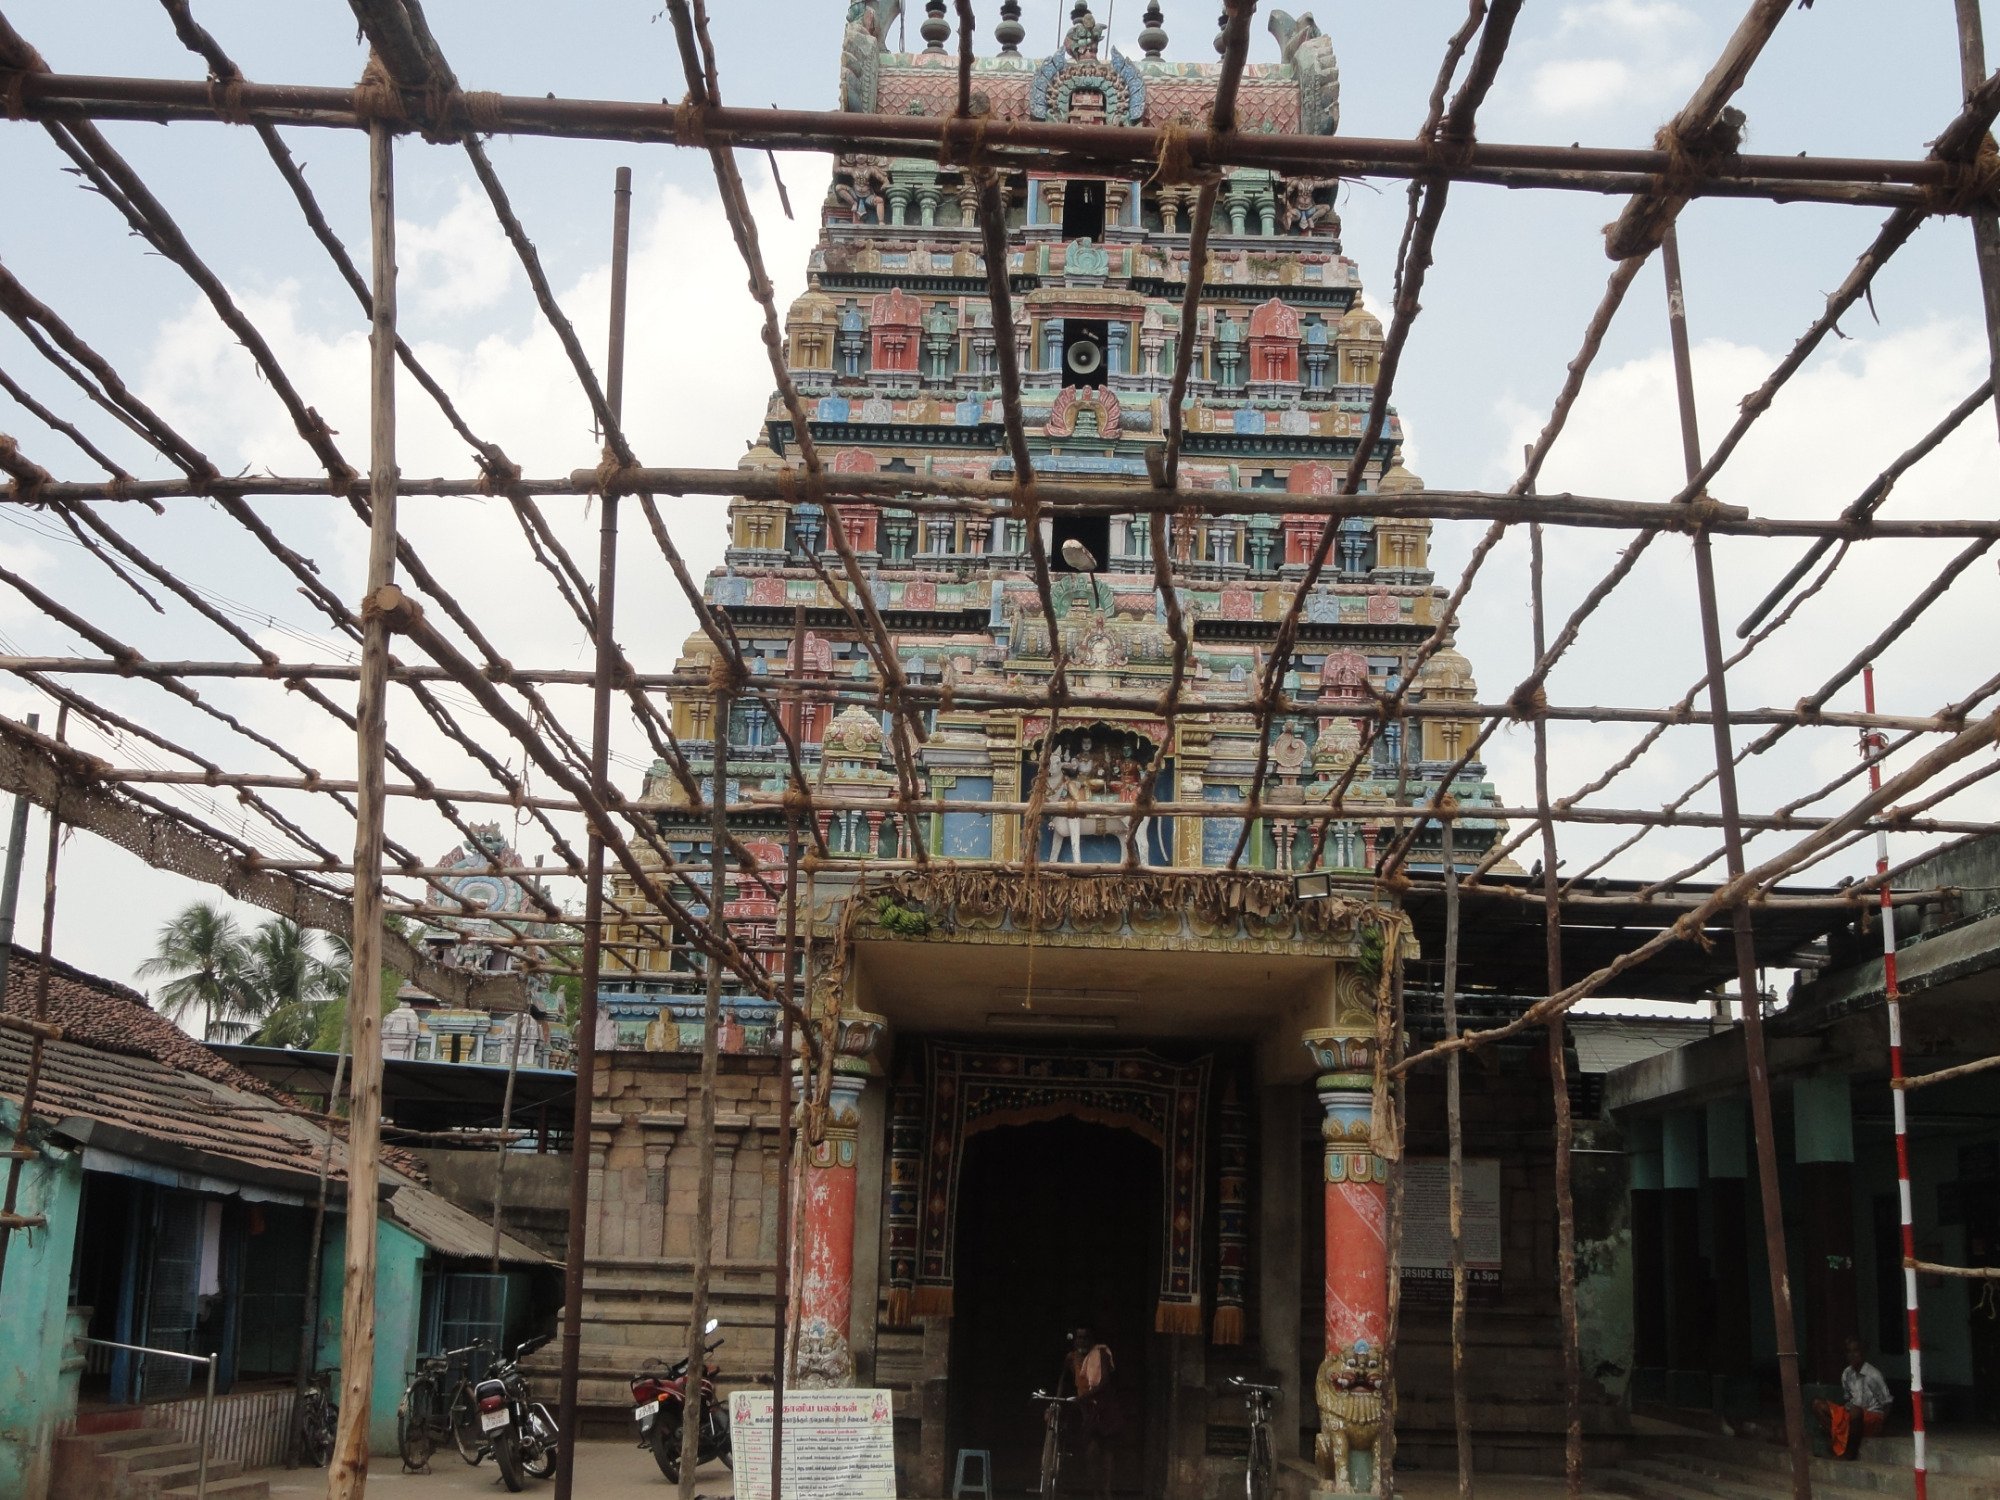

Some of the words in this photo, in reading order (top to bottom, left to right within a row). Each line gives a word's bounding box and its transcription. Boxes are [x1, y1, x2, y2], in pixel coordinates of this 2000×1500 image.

[1399, 1268, 1433, 1279] ERSIDE
[1435, 1269, 1471, 1280] REST
[1473, 1272, 1480, 1280] &
[1482, 1270, 1499, 1282] Spa
[766, 1403, 814, 1414] நதானிய
